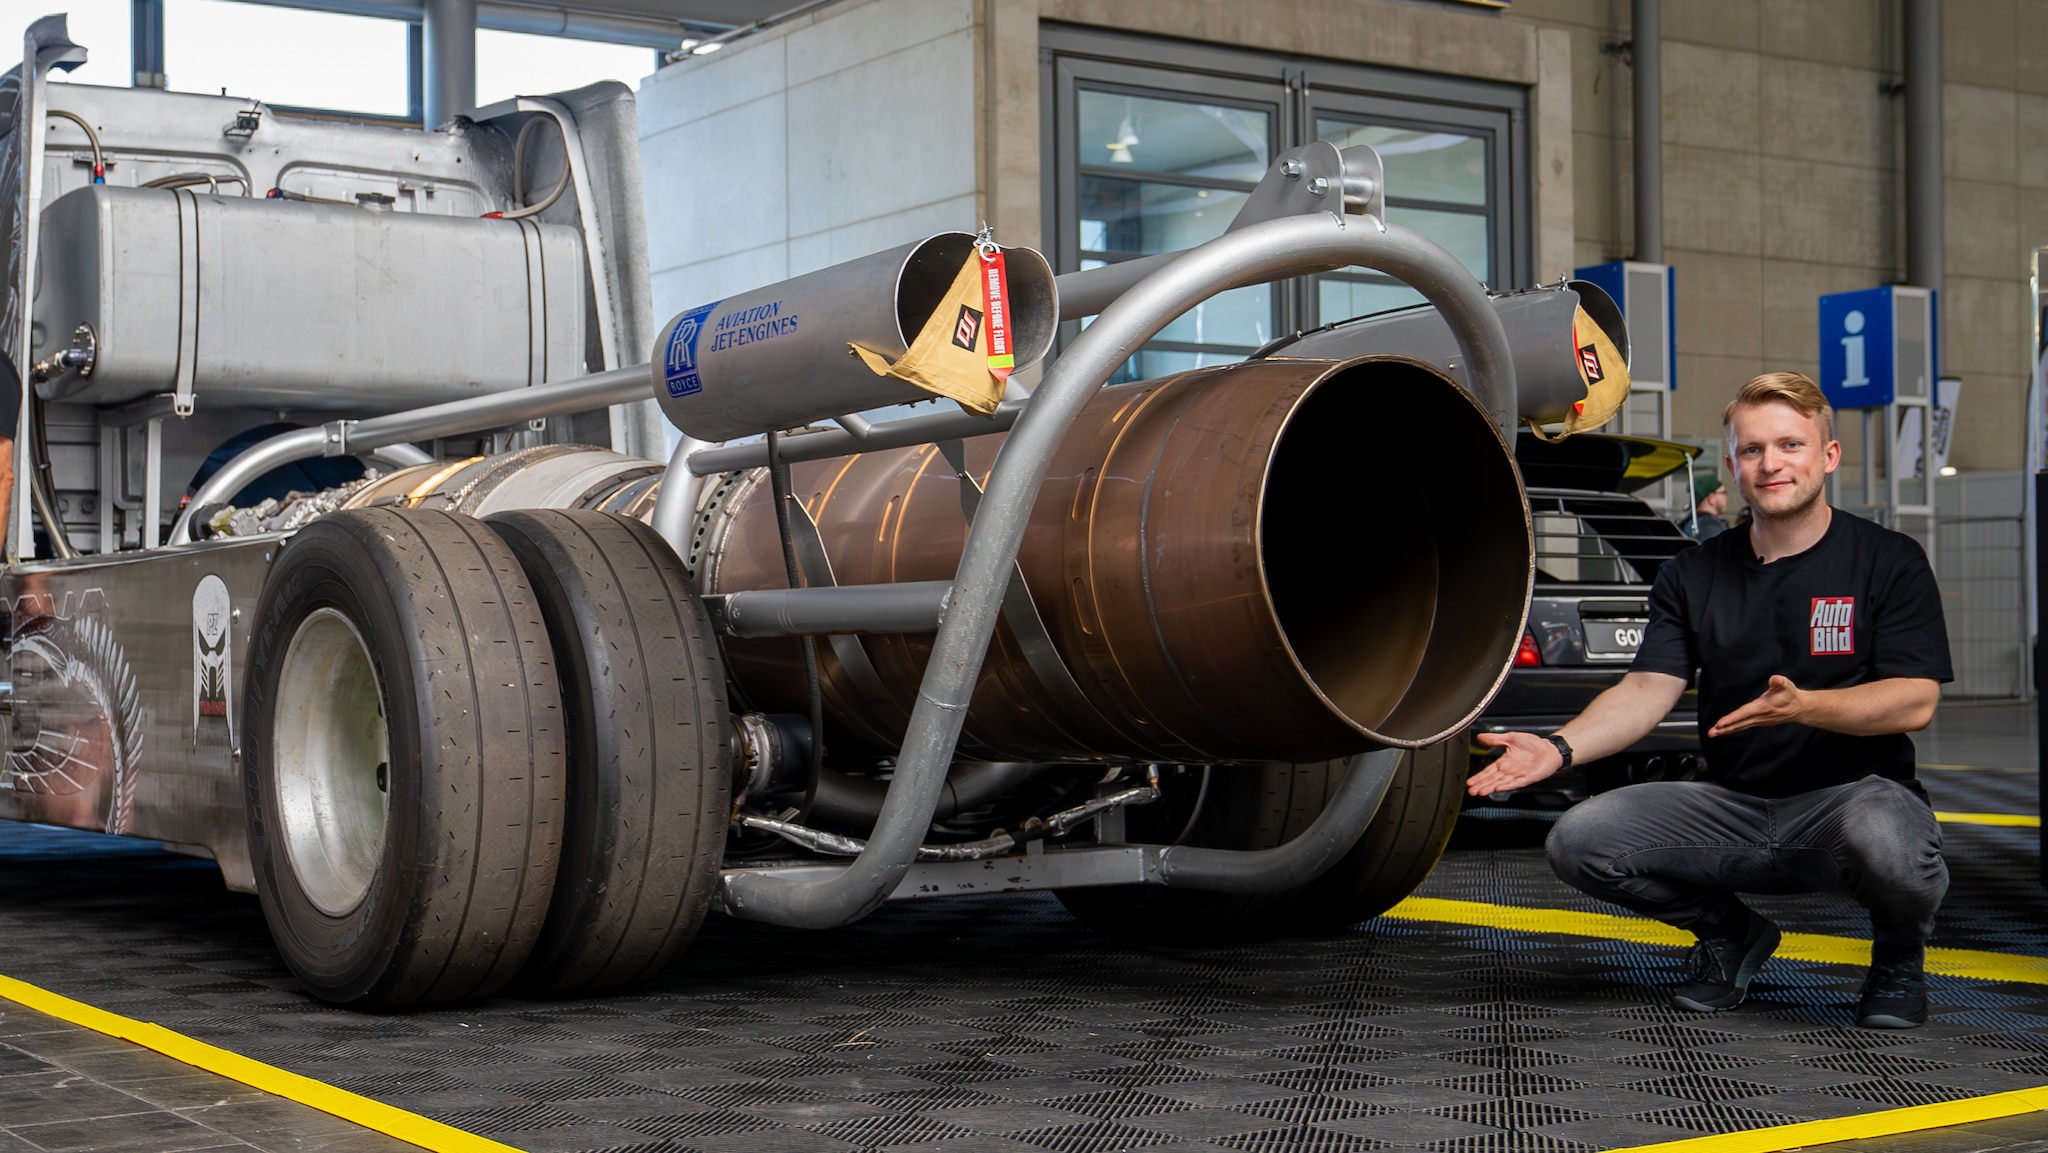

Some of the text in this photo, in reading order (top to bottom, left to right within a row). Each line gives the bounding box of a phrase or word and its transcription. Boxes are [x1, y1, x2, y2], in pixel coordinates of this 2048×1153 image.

[715, 301, 782, 331] AVIATION
[988, 268, 1006, 354] REMOVE BEFORE FLIGHT
[711, 315, 798, 352] JET-ENGINES
[1841, 310, 1870, 388] i
[670, 376, 698, 392] ROYCE
[1810, 600, 1853, 627] Auto
[1615, 628, 1643, 647] GOL
[1814, 627, 1851, 652] Bild
